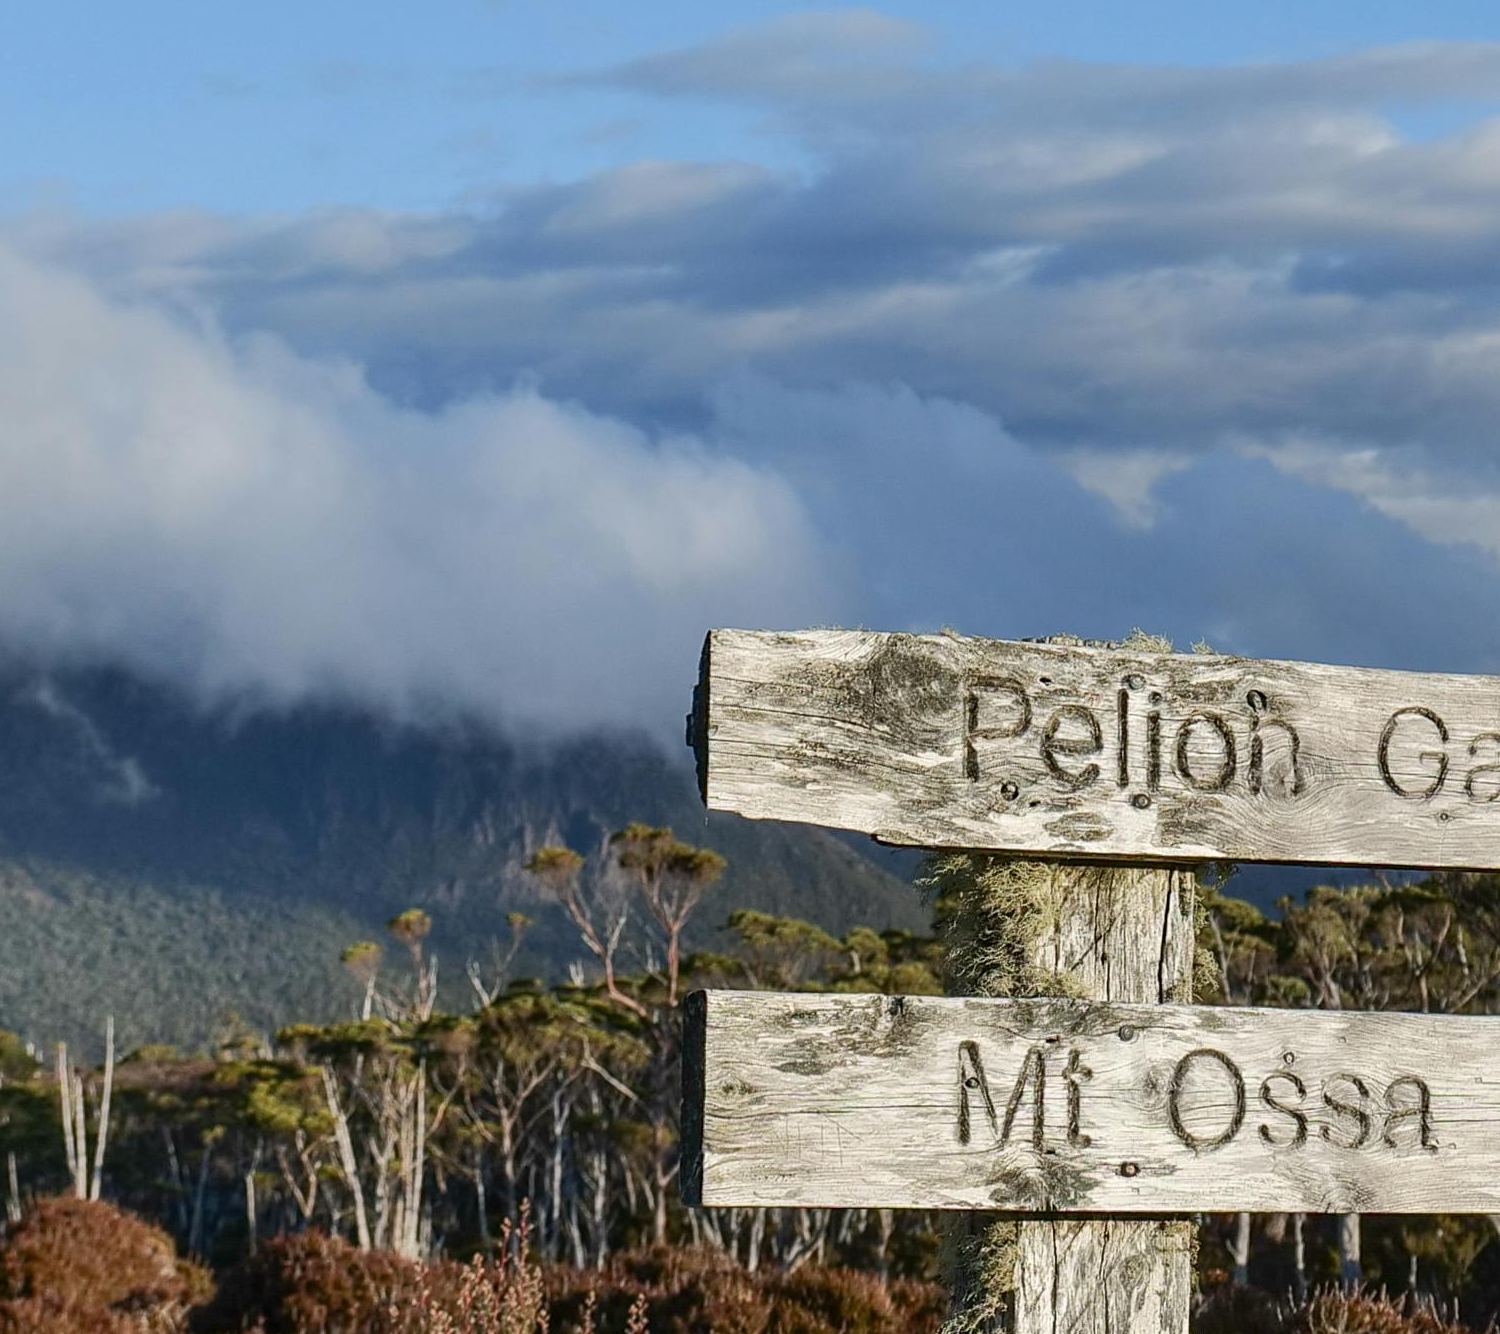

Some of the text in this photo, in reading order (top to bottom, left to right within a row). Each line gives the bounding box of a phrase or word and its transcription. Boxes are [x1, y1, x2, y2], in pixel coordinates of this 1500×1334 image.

[966, 675, 1302, 797] Pelion
[956, 1039, 1094, 1152] Mt
[1167, 1047, 1439, 1154] Ossa
